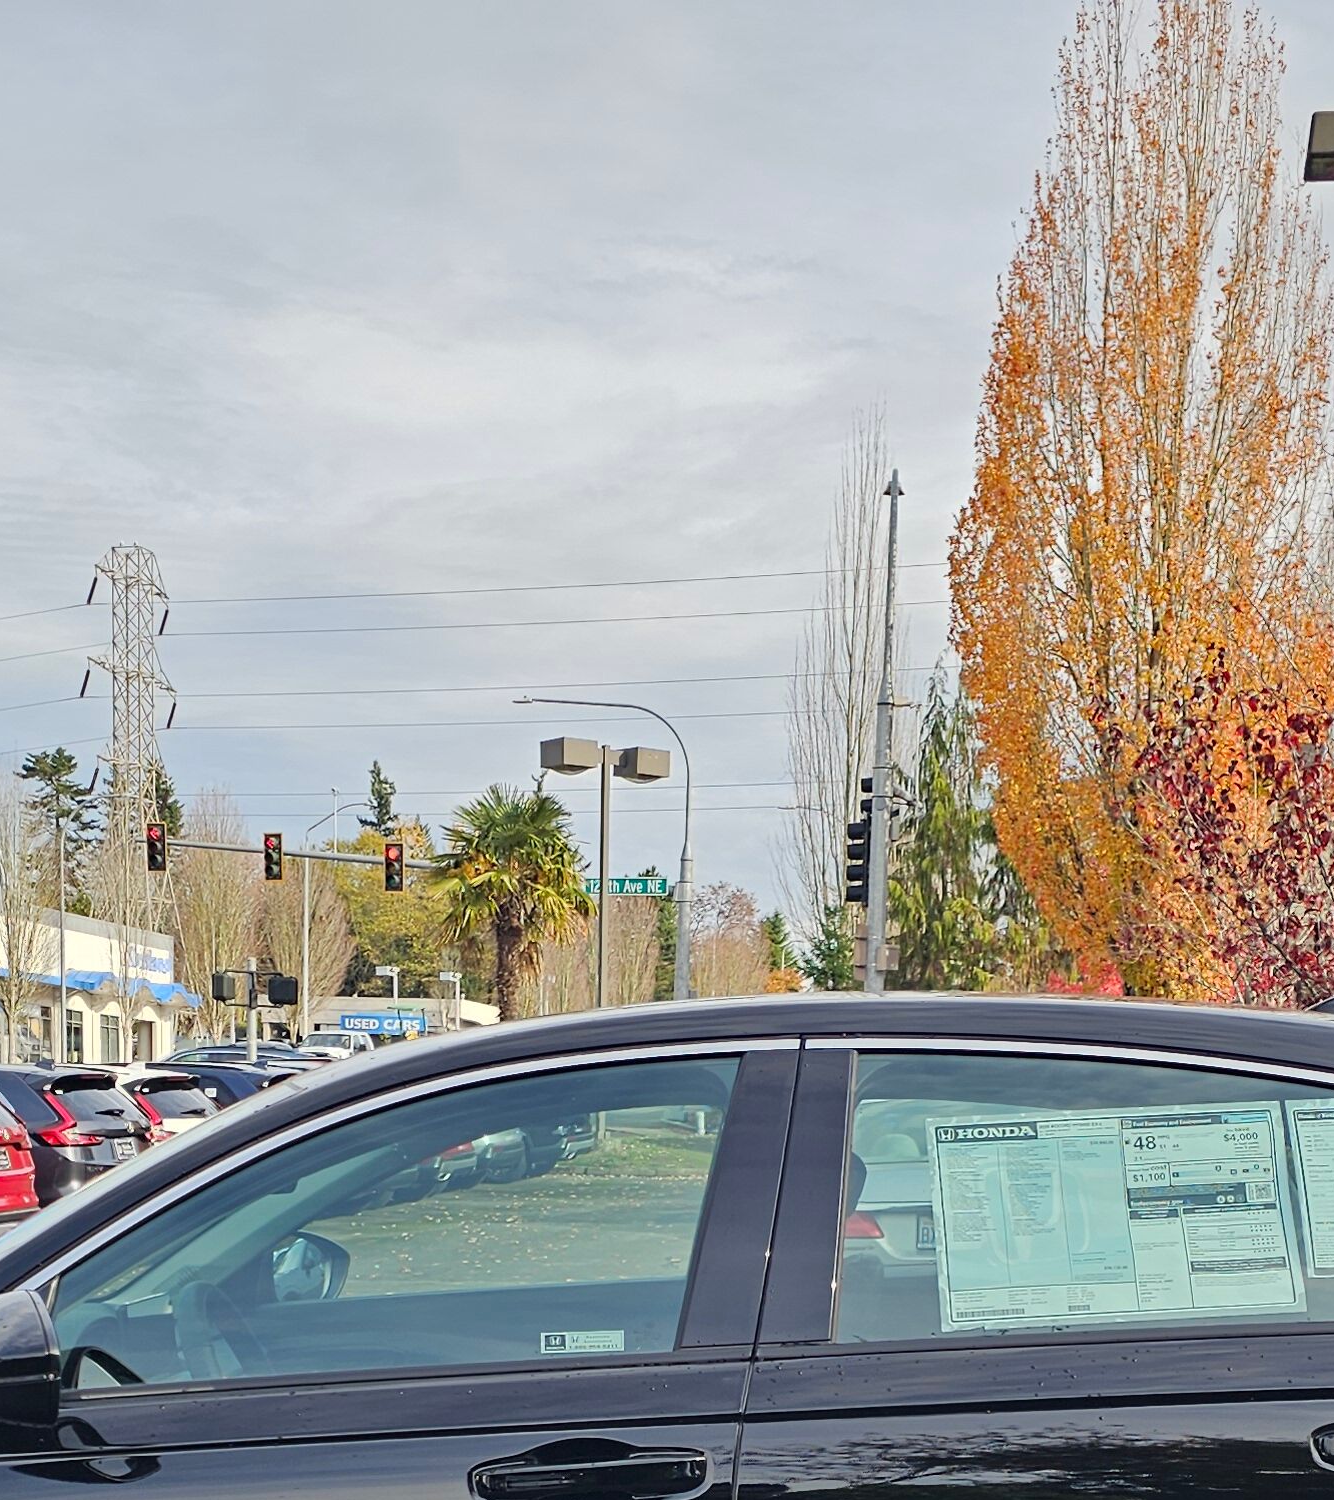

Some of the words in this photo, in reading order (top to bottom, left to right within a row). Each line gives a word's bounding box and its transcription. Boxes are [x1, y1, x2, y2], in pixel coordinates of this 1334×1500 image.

[590, 880, 620, 893] 12th
[623, 880, 643, 893] Ave
[647, 879, 663, 893] NE
[345, 1018, 380, 1030] USED
[383, 1019, 421, 1031] CARS
[956, 1125, 1036, 1140] HONDA
[1223, 1131, 1259, 1142] $4,000
[1133, 1135, 1157, 1150] 48
[1133, 1172, 1166, 1182] $1,100
